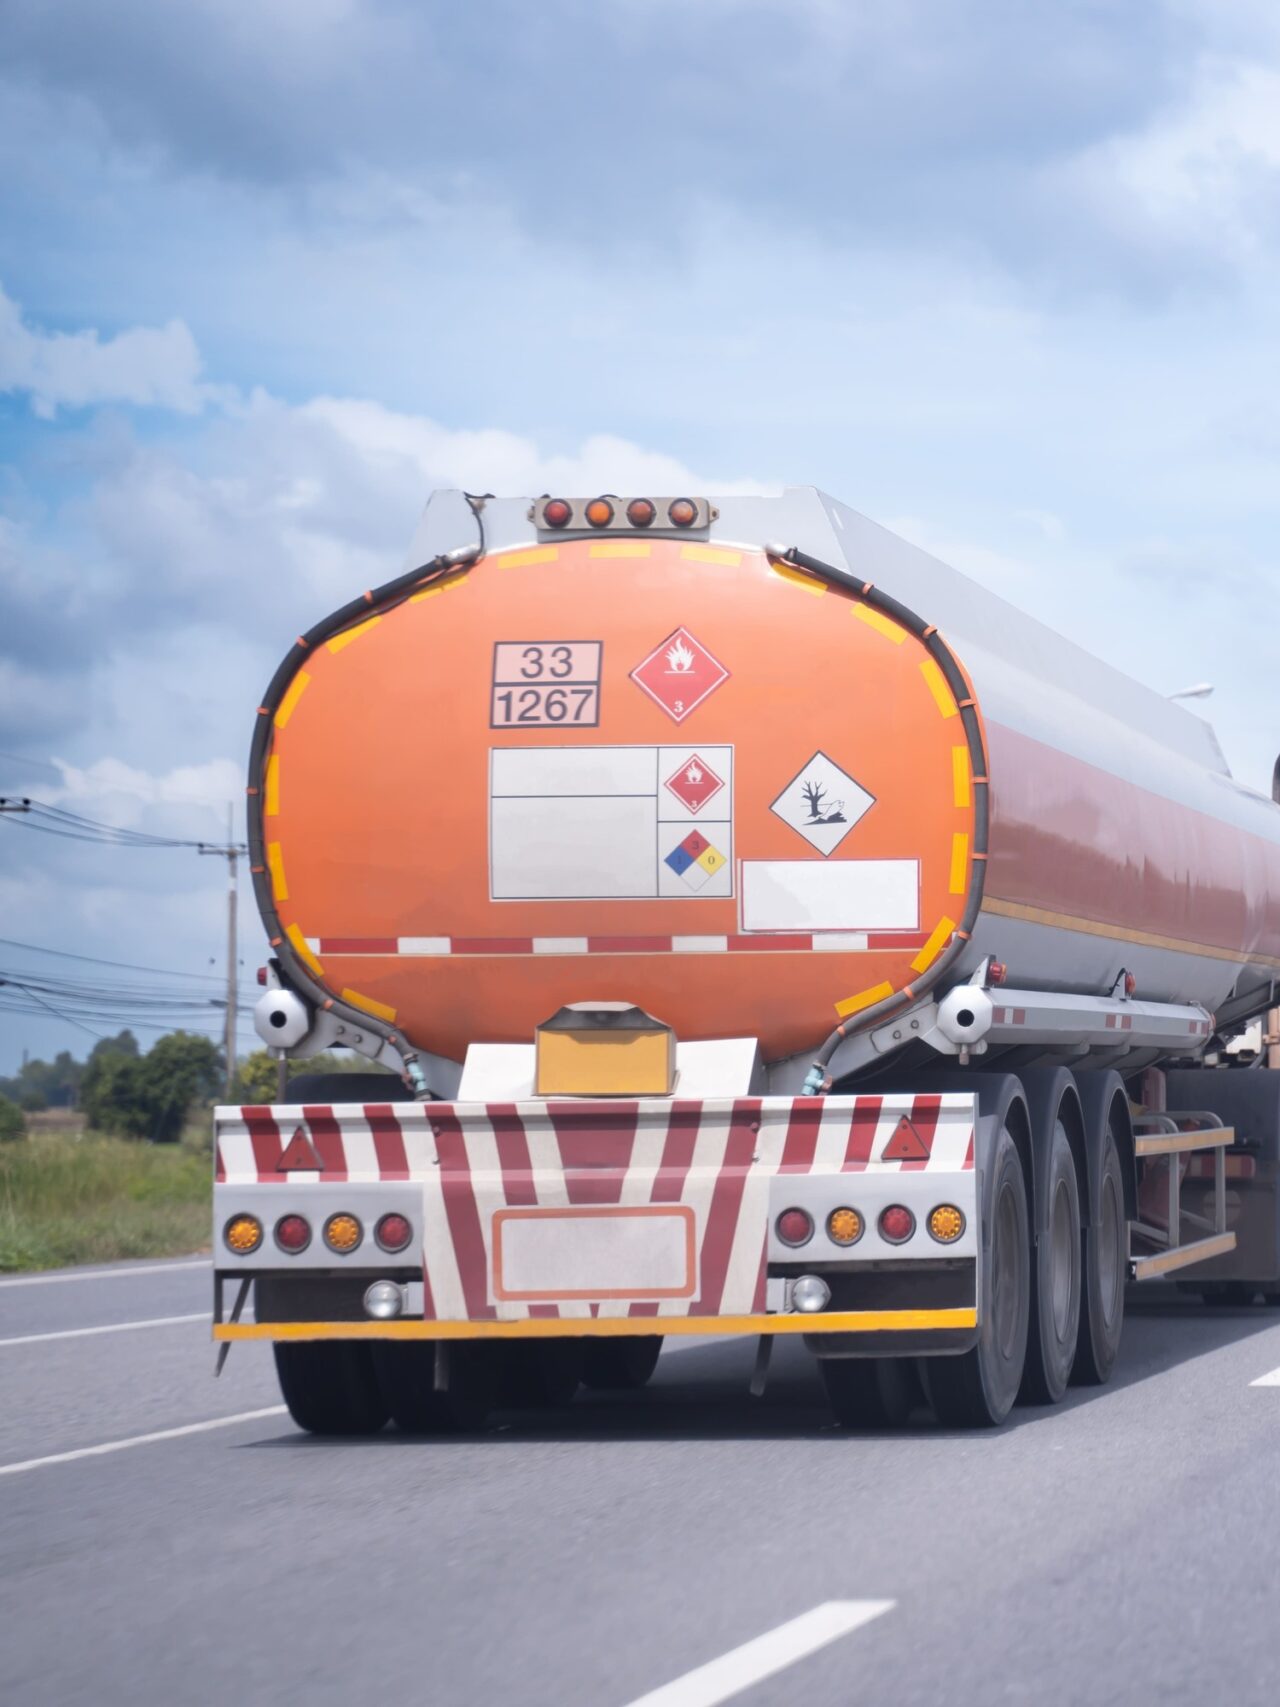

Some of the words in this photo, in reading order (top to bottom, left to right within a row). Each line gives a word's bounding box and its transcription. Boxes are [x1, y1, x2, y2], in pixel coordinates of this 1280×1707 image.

[520, 647, 573, 679] 33
[497, 689, 593, 722] 1267
[674, 701, 684, 713] 3
[691, 800, 697, 808] 3
